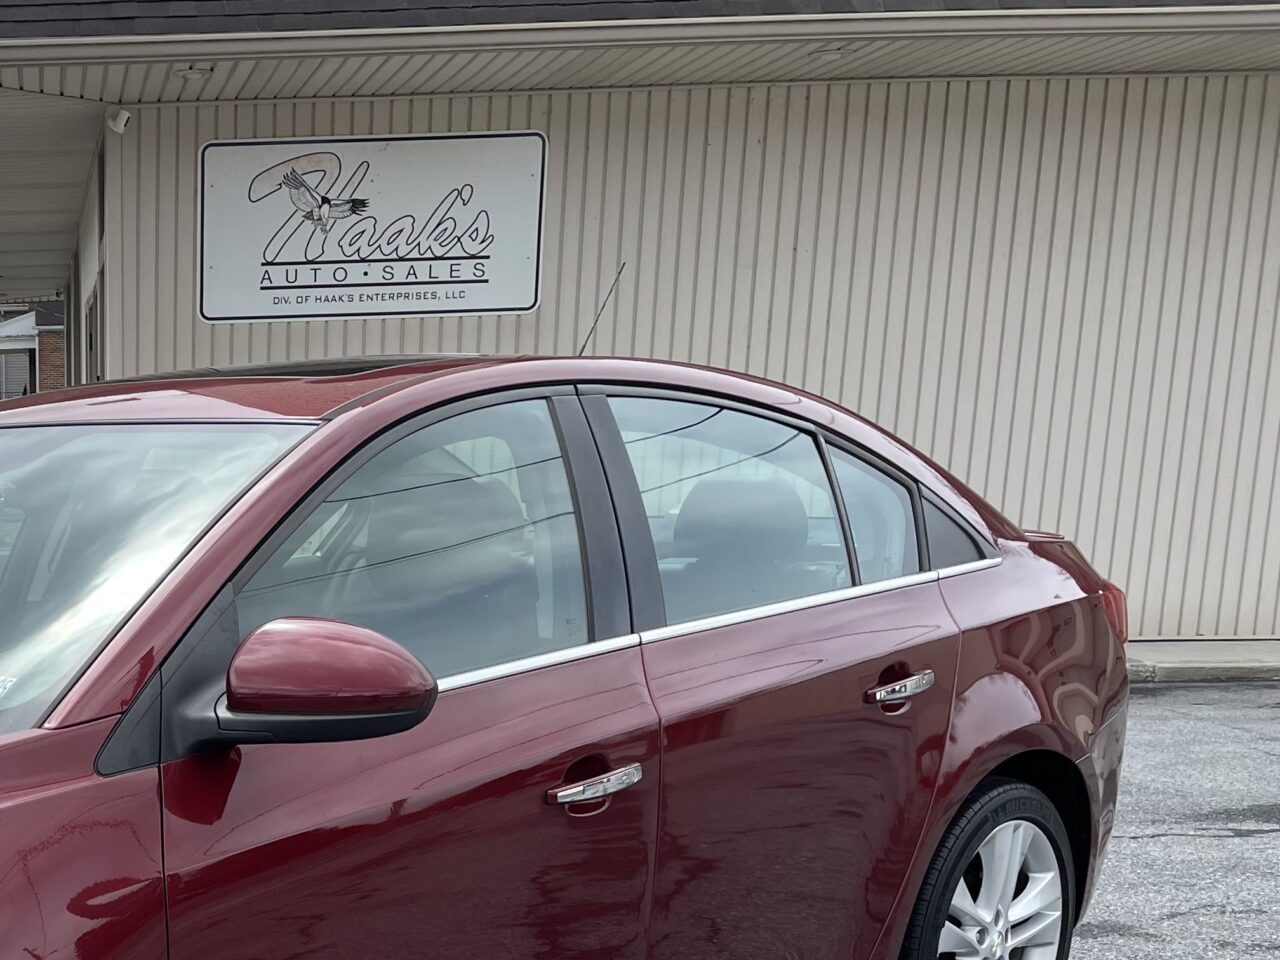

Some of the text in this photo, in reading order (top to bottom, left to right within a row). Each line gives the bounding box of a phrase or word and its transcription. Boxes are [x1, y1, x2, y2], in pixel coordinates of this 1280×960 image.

[247, 151, 495, 263] Haak's
[260, 262, 487, 285] AUTO SALES
[272, 290, 466, 305] DIV. OF HAAK'S ENTERPRISES, LLC
